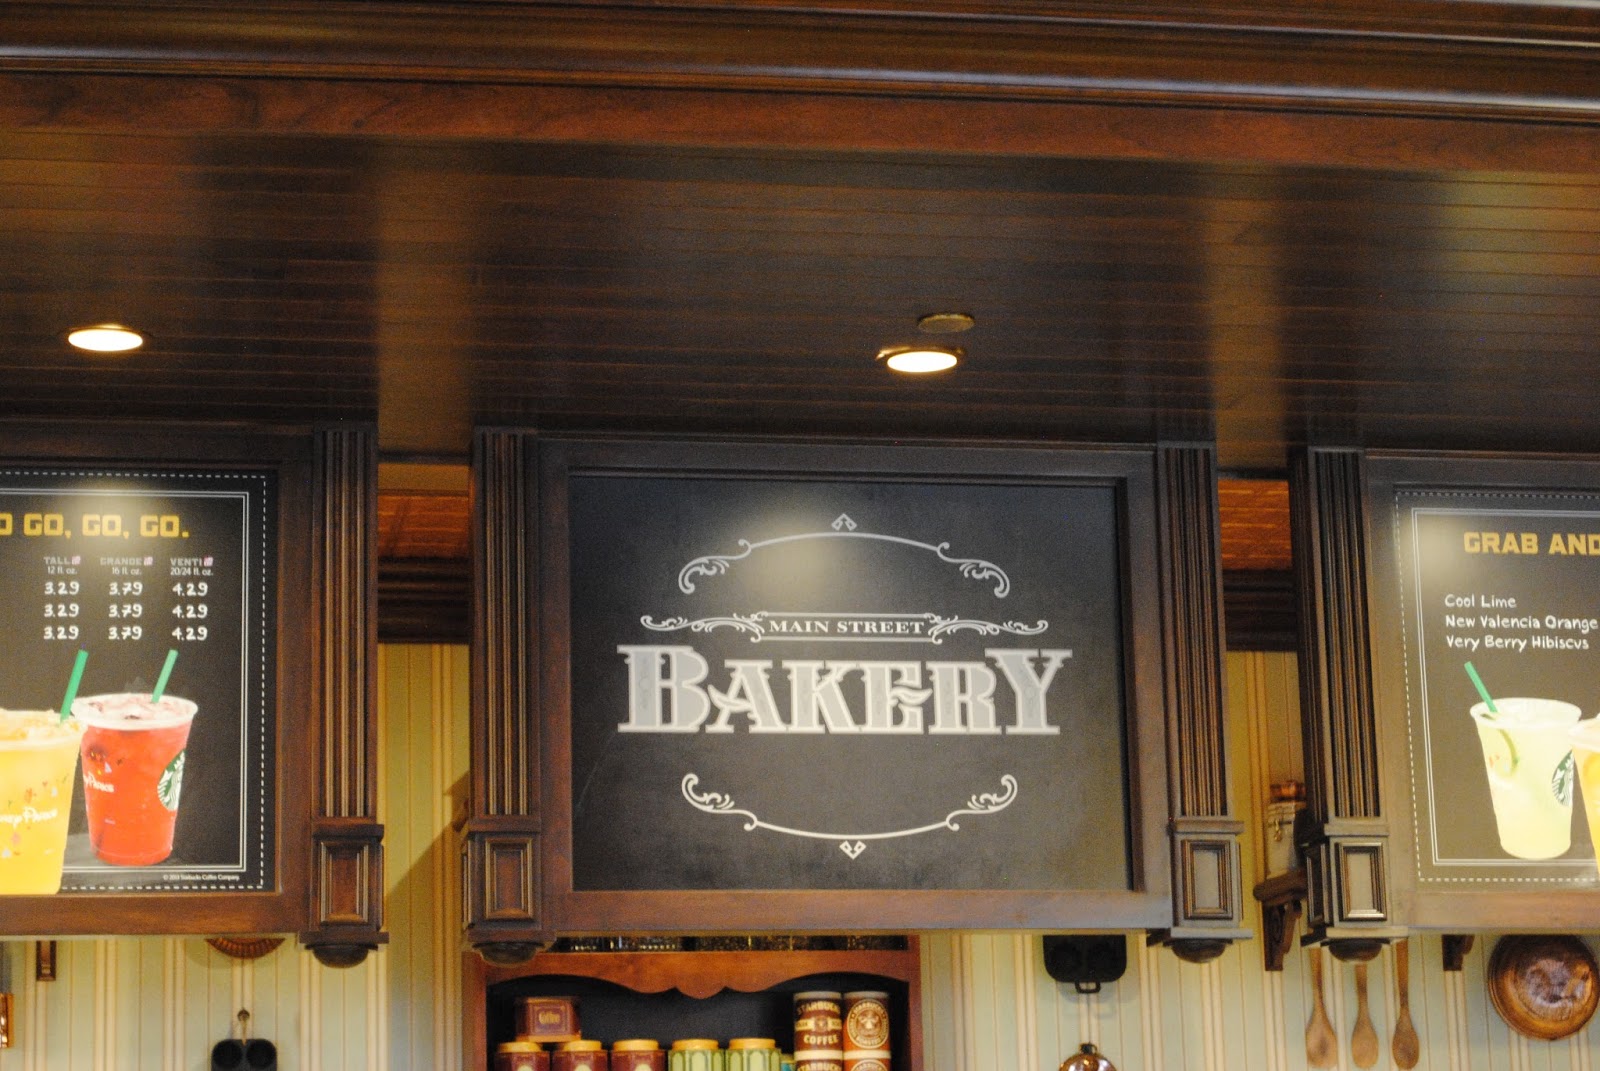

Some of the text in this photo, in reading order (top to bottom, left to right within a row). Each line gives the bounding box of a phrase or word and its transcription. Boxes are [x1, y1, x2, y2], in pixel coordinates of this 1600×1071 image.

[23, 513, 72, 539] GO,
[82, 513, 130, 540] GO,
[140, 514, 190, 538] GO.
[1463, 531, 1600, 556] GRAB AND
[43, 556, 71, 566] TALL
[100, 556, 143, 566] GRANDE
[170, 557, 202, 567] VENTI
[44, 581, 209, 597] 3.29 3.79 4.29
[1444, 593, 1517, 609] Cool Lime
[44, 603, 208, 619] 3.29 3.79 4.29
[768, 620, 925, 634] MAIN STREET
[1445, 614, 1599, 634] New Valencia Orange
[43, 625, 208, 641] 3.29 3.79 4.29
[1446, 634, 1590, 653] Very Berry Hibiscus
[617, 644, 1073, 736] BAKERY
[803, 1034, 839, 1046] COFFEE
